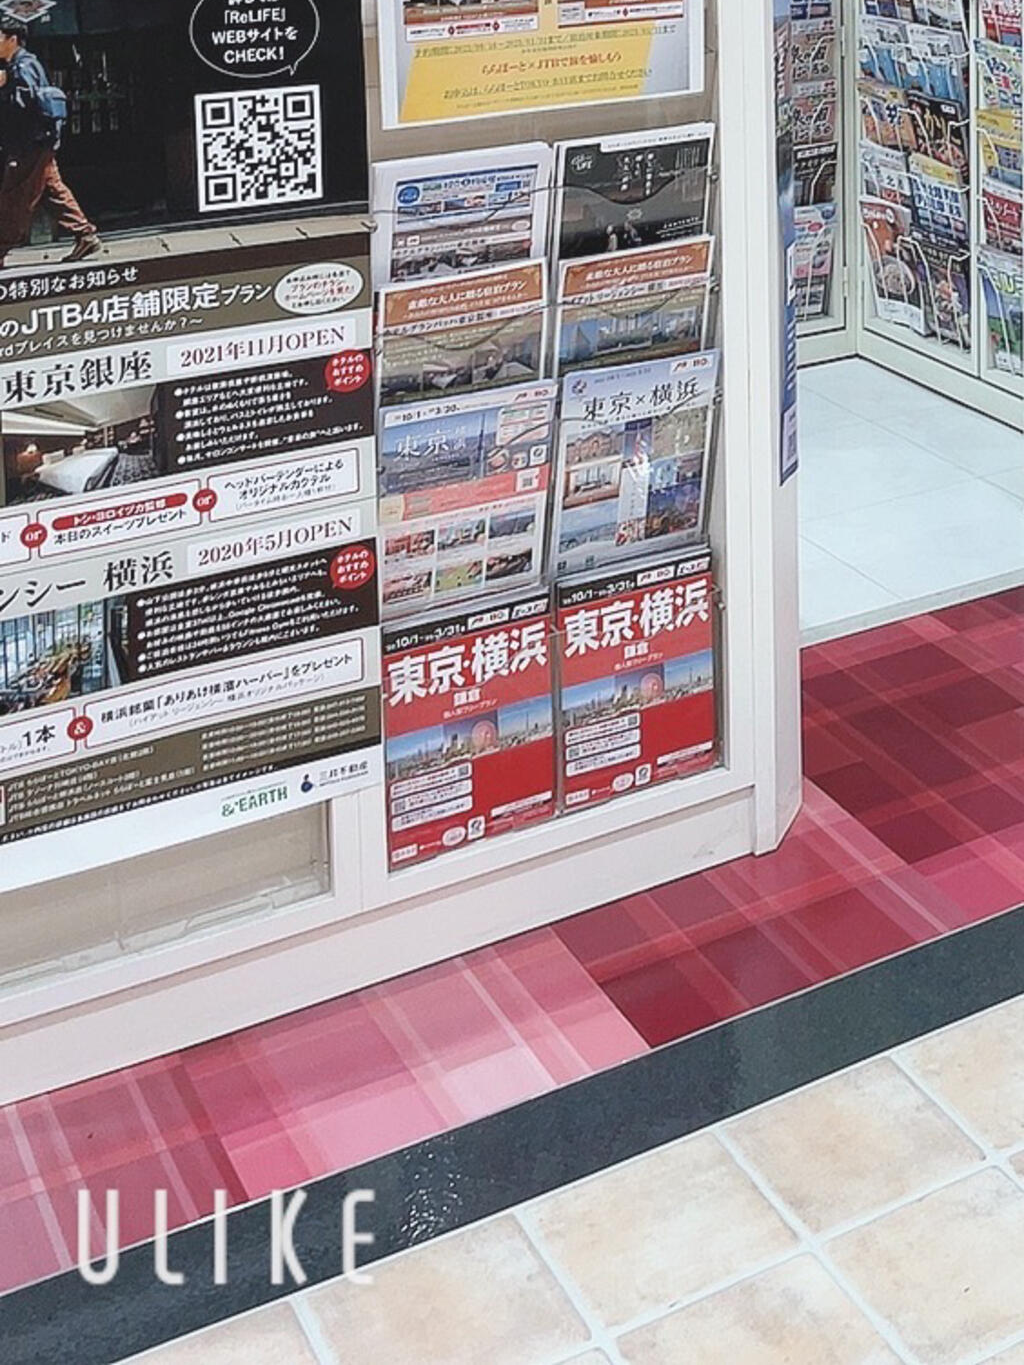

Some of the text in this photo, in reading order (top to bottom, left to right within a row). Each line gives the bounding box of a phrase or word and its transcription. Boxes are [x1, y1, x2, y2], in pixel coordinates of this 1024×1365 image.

[212, 27, 298, 45] WEBサイトを
[224, 46, 285, 63] CHECK!
[1, 281, 272, 338] のJTB4店舗限定プラン
[181, 325, 346, 369] 2021年11月OPEN
[331, 351, 364, 366] ホテルの
[1, 350, 153, 404] 東京銀座
[332, 362, 363, 375] おすすめ
[333, 373, 362, 385] ポイント
[197, 493, 213, 507] or
[24, 529, 43, 542] or
[198, 517, 354, 566] 2020年5月OPEN
[336, 551, 369, 565] ホテルの
[103, 553, 174, 592] 横浜
[337, 561, 370, 574] おすすめ
[339, 572, 367, 584] ポイント
[564, 579, 709, 659] 東京・横浜
[387, 621, 547, 706] 東京・横浜
